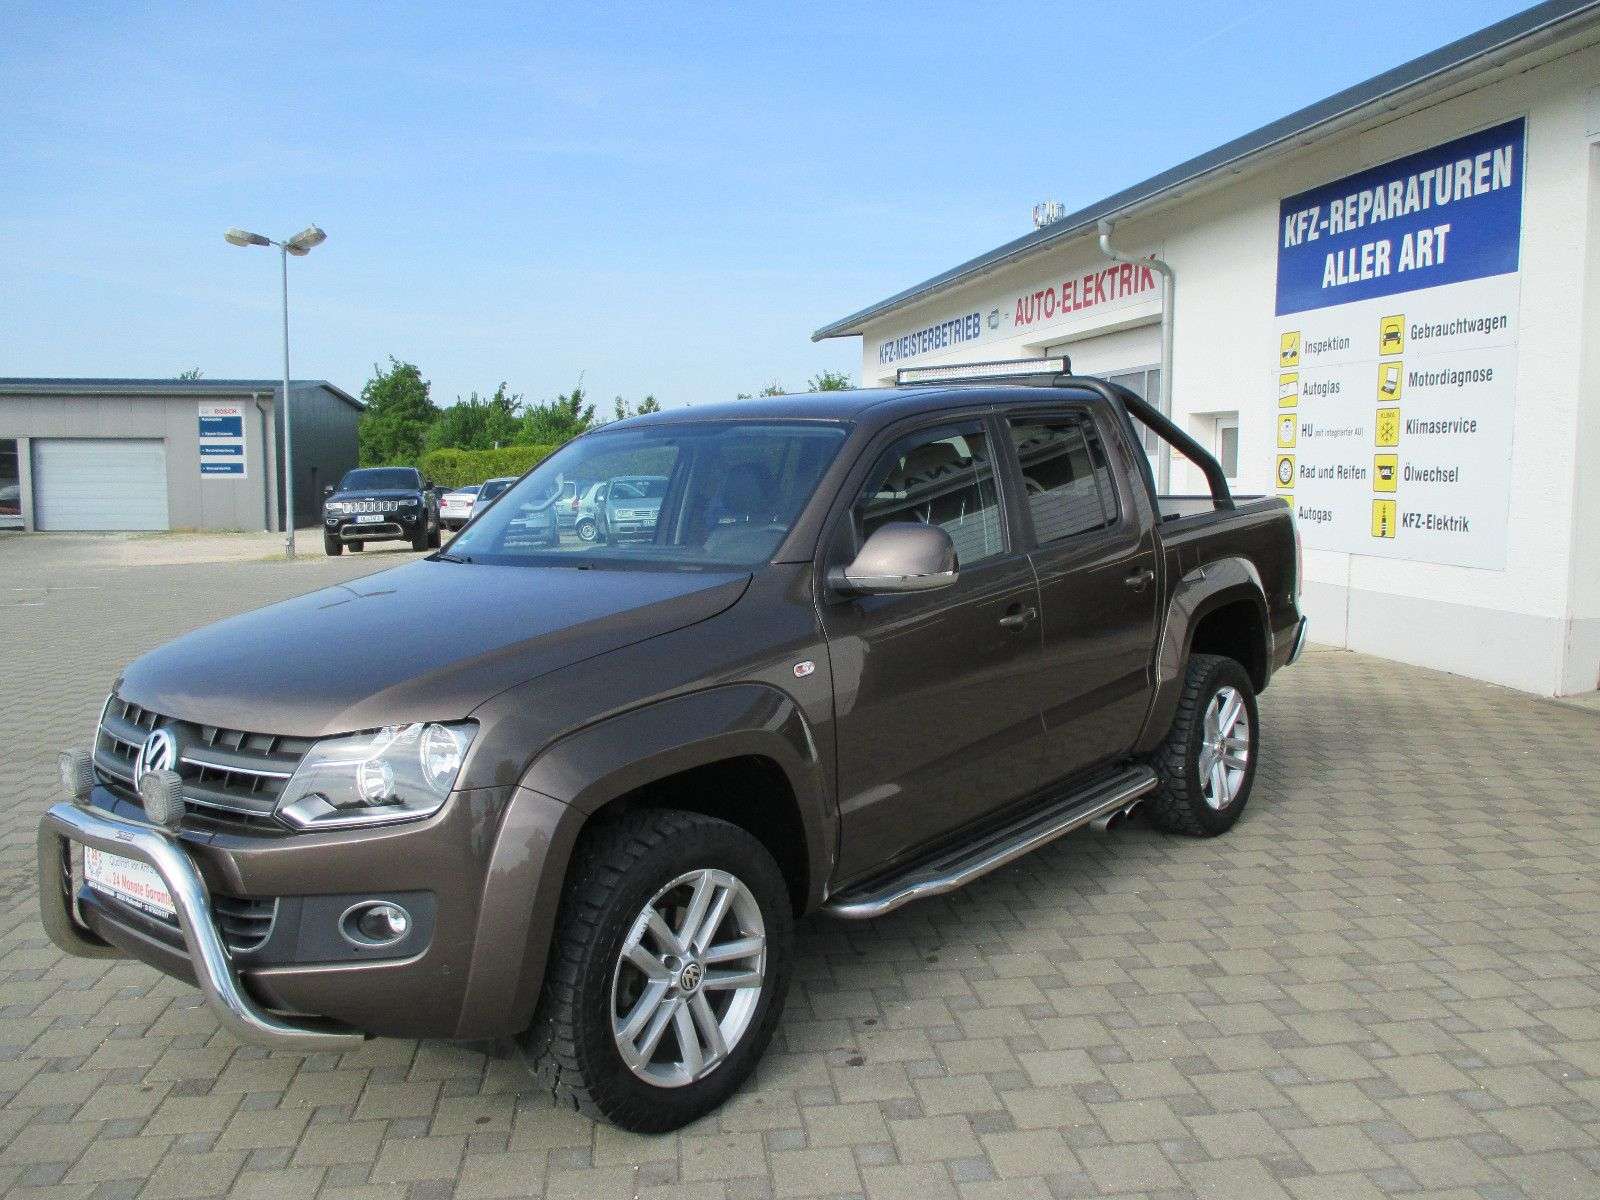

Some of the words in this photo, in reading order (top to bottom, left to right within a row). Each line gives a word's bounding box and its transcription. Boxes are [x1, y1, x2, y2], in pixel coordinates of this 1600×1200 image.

[1285, 146, 1513, 248] KFZ-REPARATUREN
[1321, 239, 1391, 289] ALLER
[1398, 224, 1451, 273] ART
[1015, 254, 1156, 326] AUTO-ELEKTRIK
[1411, 314, 1507, 340] Gebrauchtwagen
[879, 312, 981, 365] KFZ-MEISTERBETRIEB
[1304, 336, 1350, 355] Inspektion
[1408, 367, 1493, 388] Motordiagnose
[1302, 381, 1340, 398] Autoglas
[1301, 423, 1313, 438] HU
[1405, 418, 1477, 435] Klimaservice
[1300, 465, 1316, 479] Rad
[1318, 465, 1334, 479] und
[1337, 464, 1366, 480] Reifen
[1404, 462, 1459, 483] Ölwechsel
[1298, 506, 1332, 523] Autogas
[1402, 512, 1470, 533] KFZ-Elektrik
